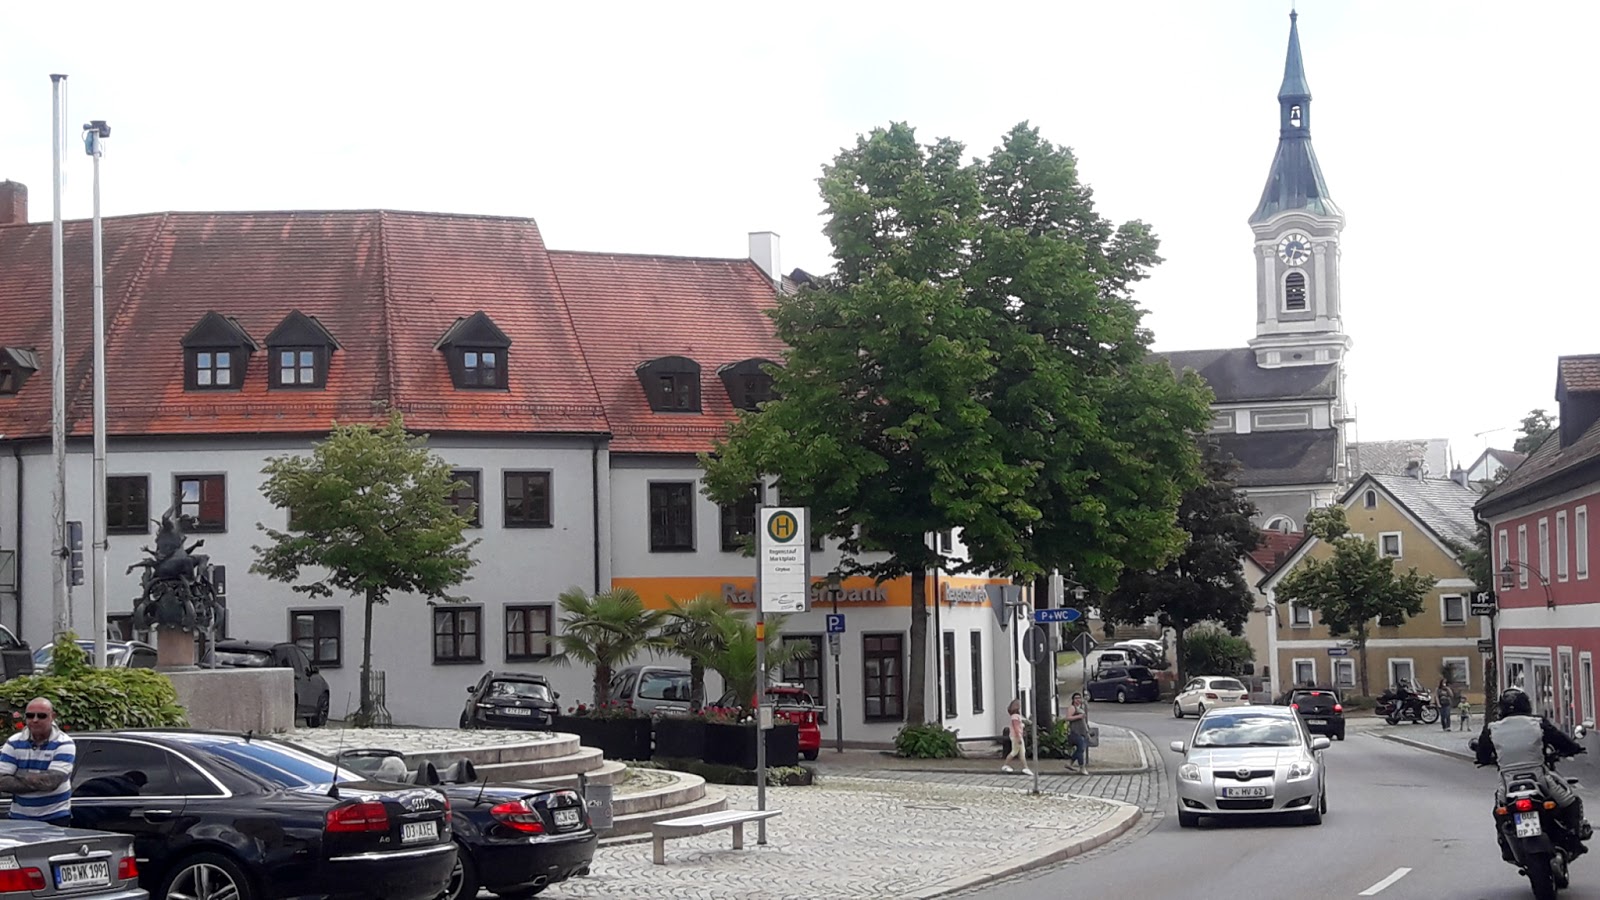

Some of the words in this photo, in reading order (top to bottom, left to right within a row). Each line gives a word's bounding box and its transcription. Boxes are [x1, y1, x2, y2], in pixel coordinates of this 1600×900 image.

[776, 518, 789, 536] H
[829, 616, 840, 632] P
[90, 862, 108, 879] 1991
